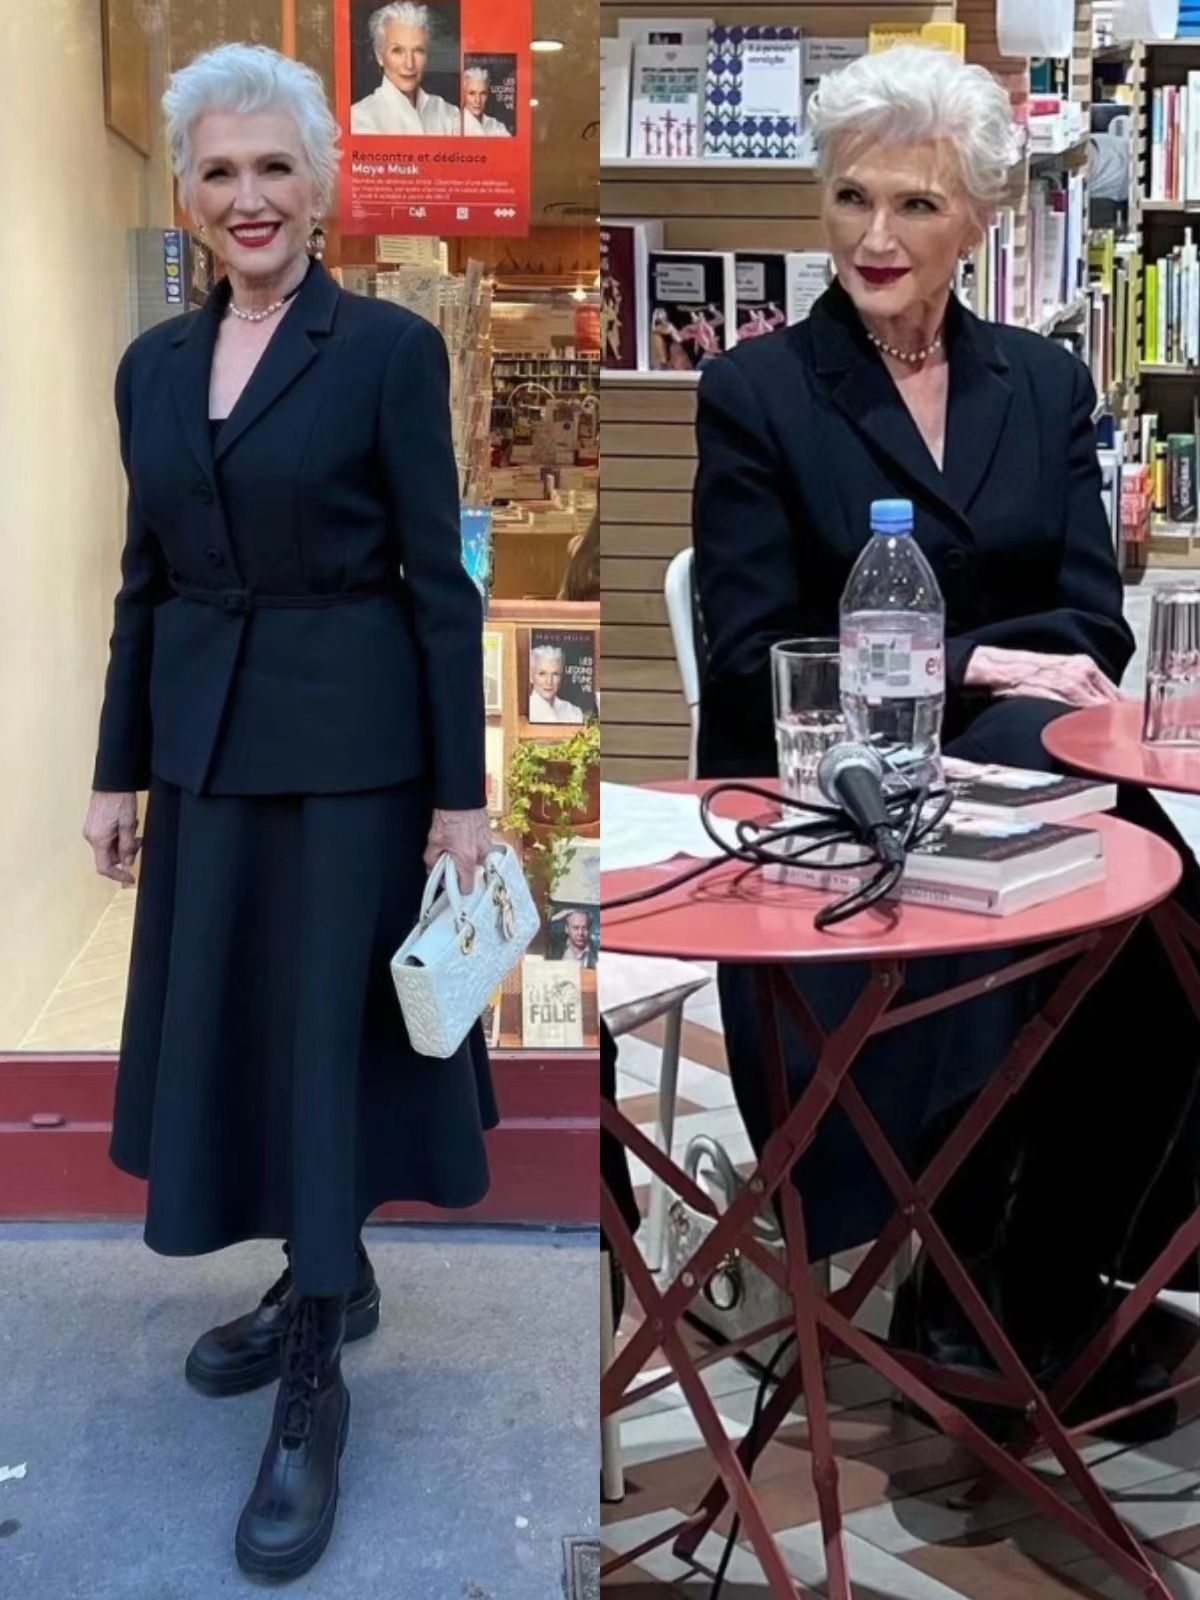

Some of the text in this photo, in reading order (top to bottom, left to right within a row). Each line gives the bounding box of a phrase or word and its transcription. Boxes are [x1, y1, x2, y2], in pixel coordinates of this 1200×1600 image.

[352, 151, 487, 163] Rencontre et dédicace
[352, 163, 419, 177] Maye Musk
[578, 656, 593, 666] LES
[580, 684, 593, 693] VIE
